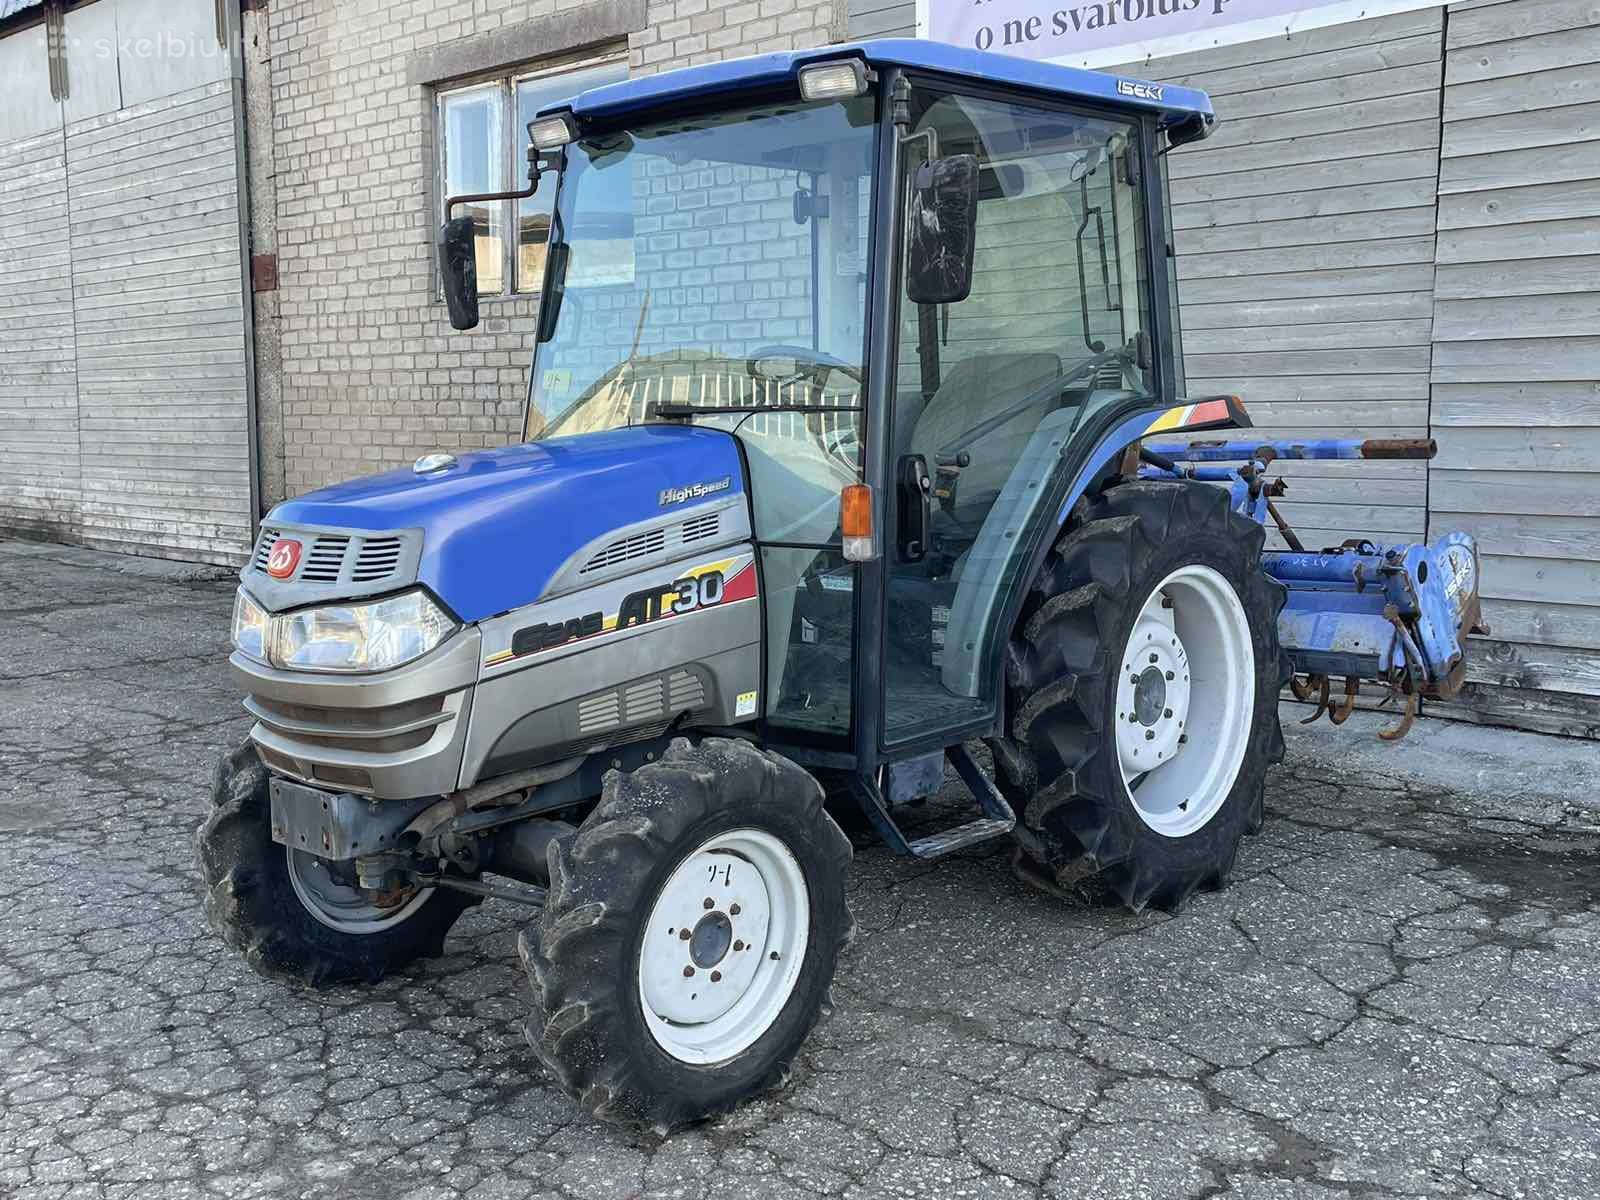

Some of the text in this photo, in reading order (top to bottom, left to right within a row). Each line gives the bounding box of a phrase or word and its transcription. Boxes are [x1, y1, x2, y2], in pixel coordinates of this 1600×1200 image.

[975, 26, 994, 51] o
[1003, 16, 1042, 46] ne
[1117, 79, 1164, 101] ISEKI
[616, 570, 724, 629] AT30
